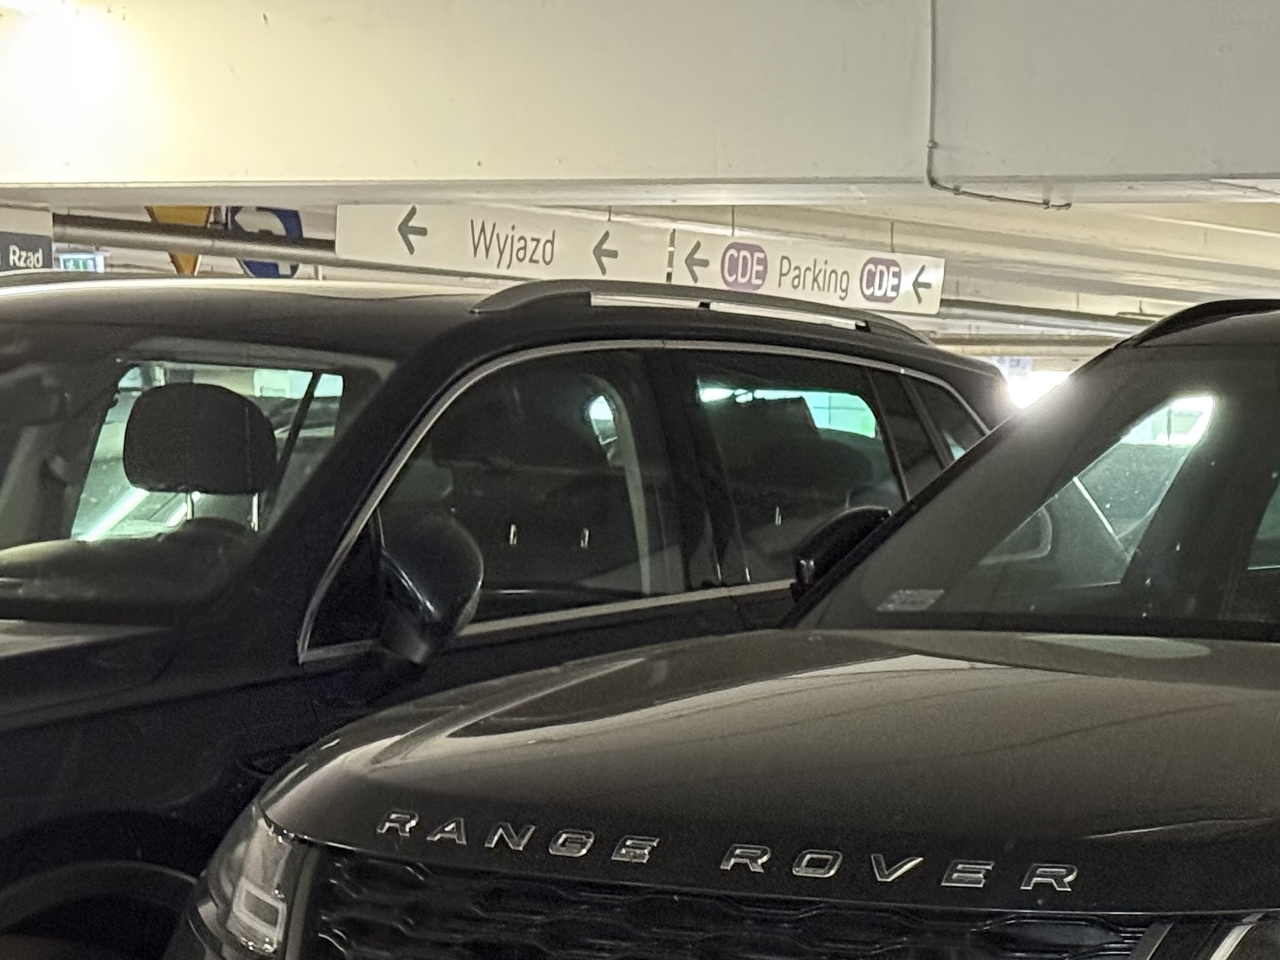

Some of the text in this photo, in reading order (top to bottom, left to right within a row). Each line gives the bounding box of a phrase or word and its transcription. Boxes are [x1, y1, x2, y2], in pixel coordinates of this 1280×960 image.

[470, 219, 556, 270] Wyjazd
[723, 248, 900, 301] CDE Parking CDE
[376, 810, 1079, 892] RANGE ROVER
